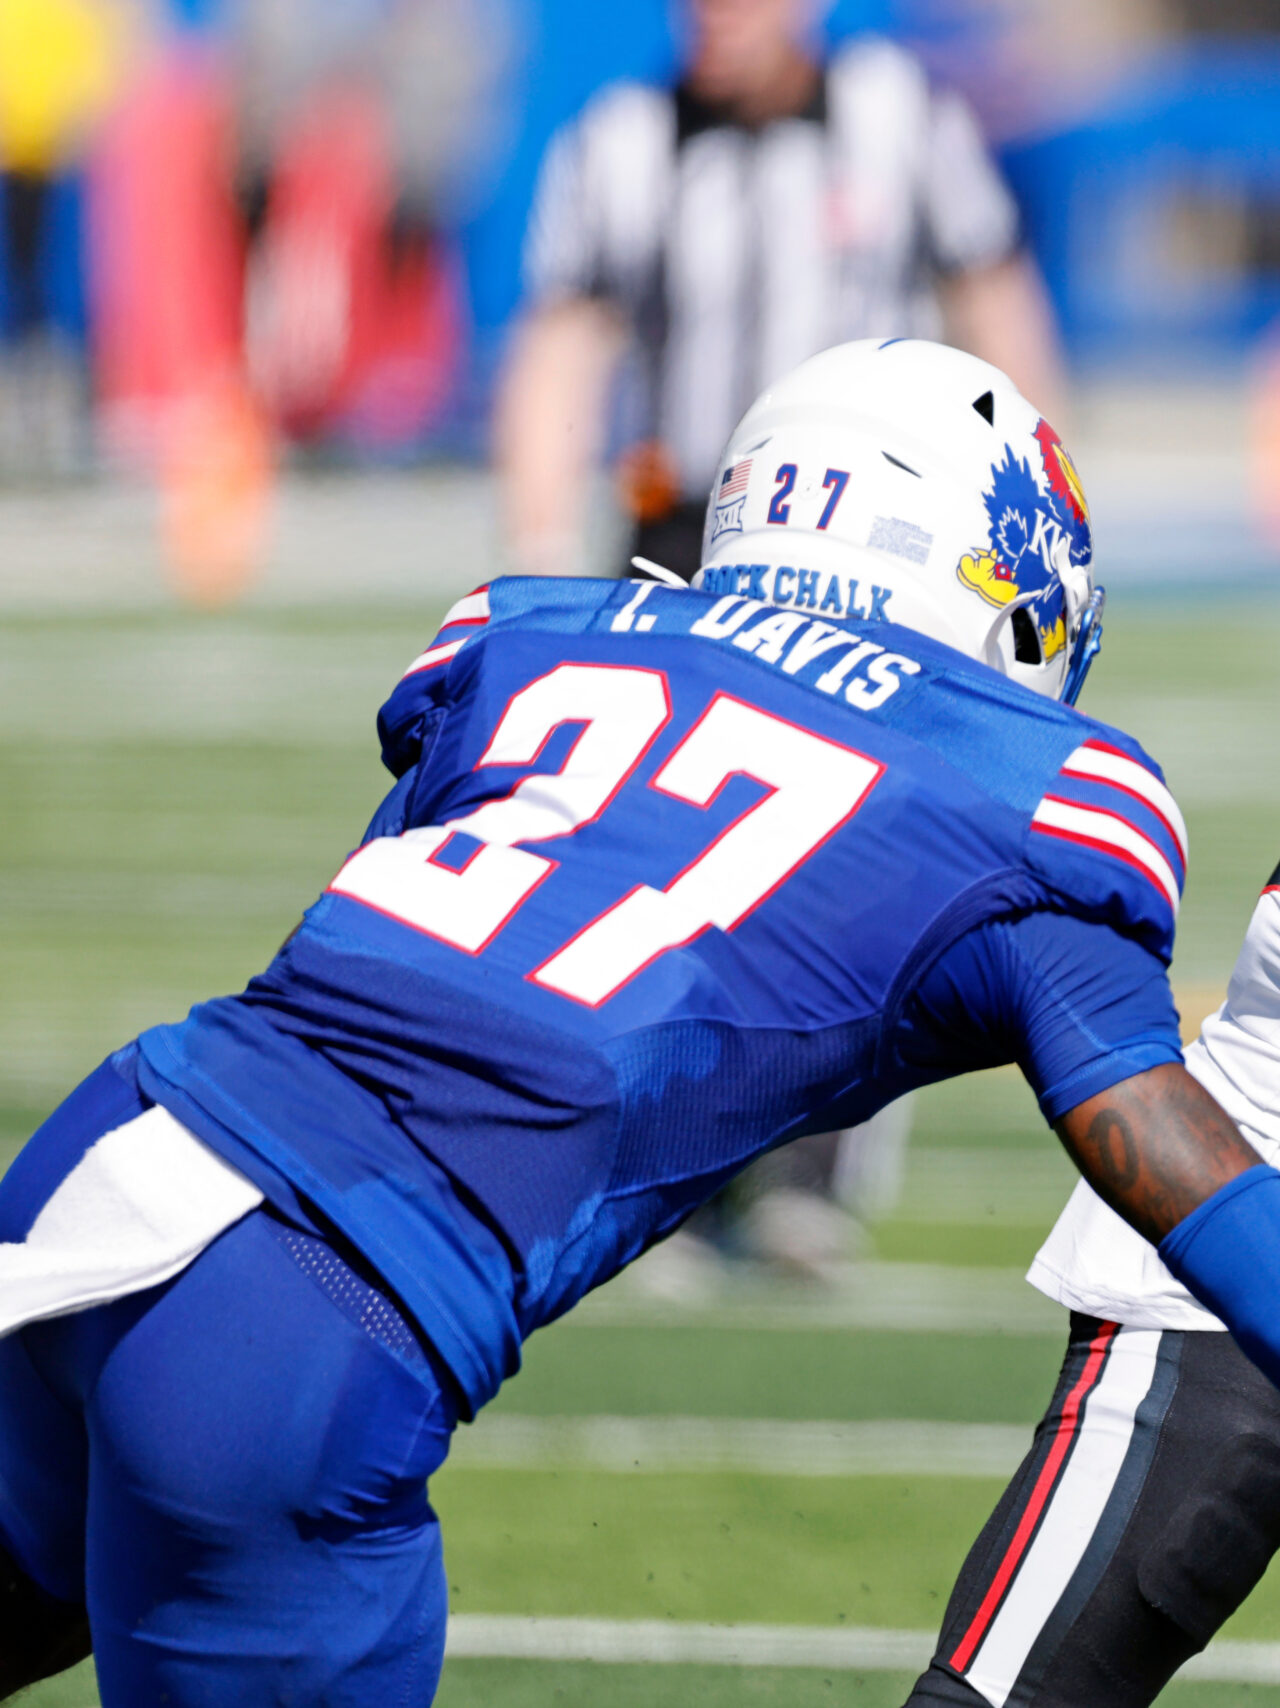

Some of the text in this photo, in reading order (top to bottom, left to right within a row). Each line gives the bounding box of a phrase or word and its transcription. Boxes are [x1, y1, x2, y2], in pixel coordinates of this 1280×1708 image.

[767, 463, 852, 531] 27
[772, 565, 893, 623] CHALK
[689, 594, 922, 711] DAVIS
[325, 661, 888, 1010] 27
